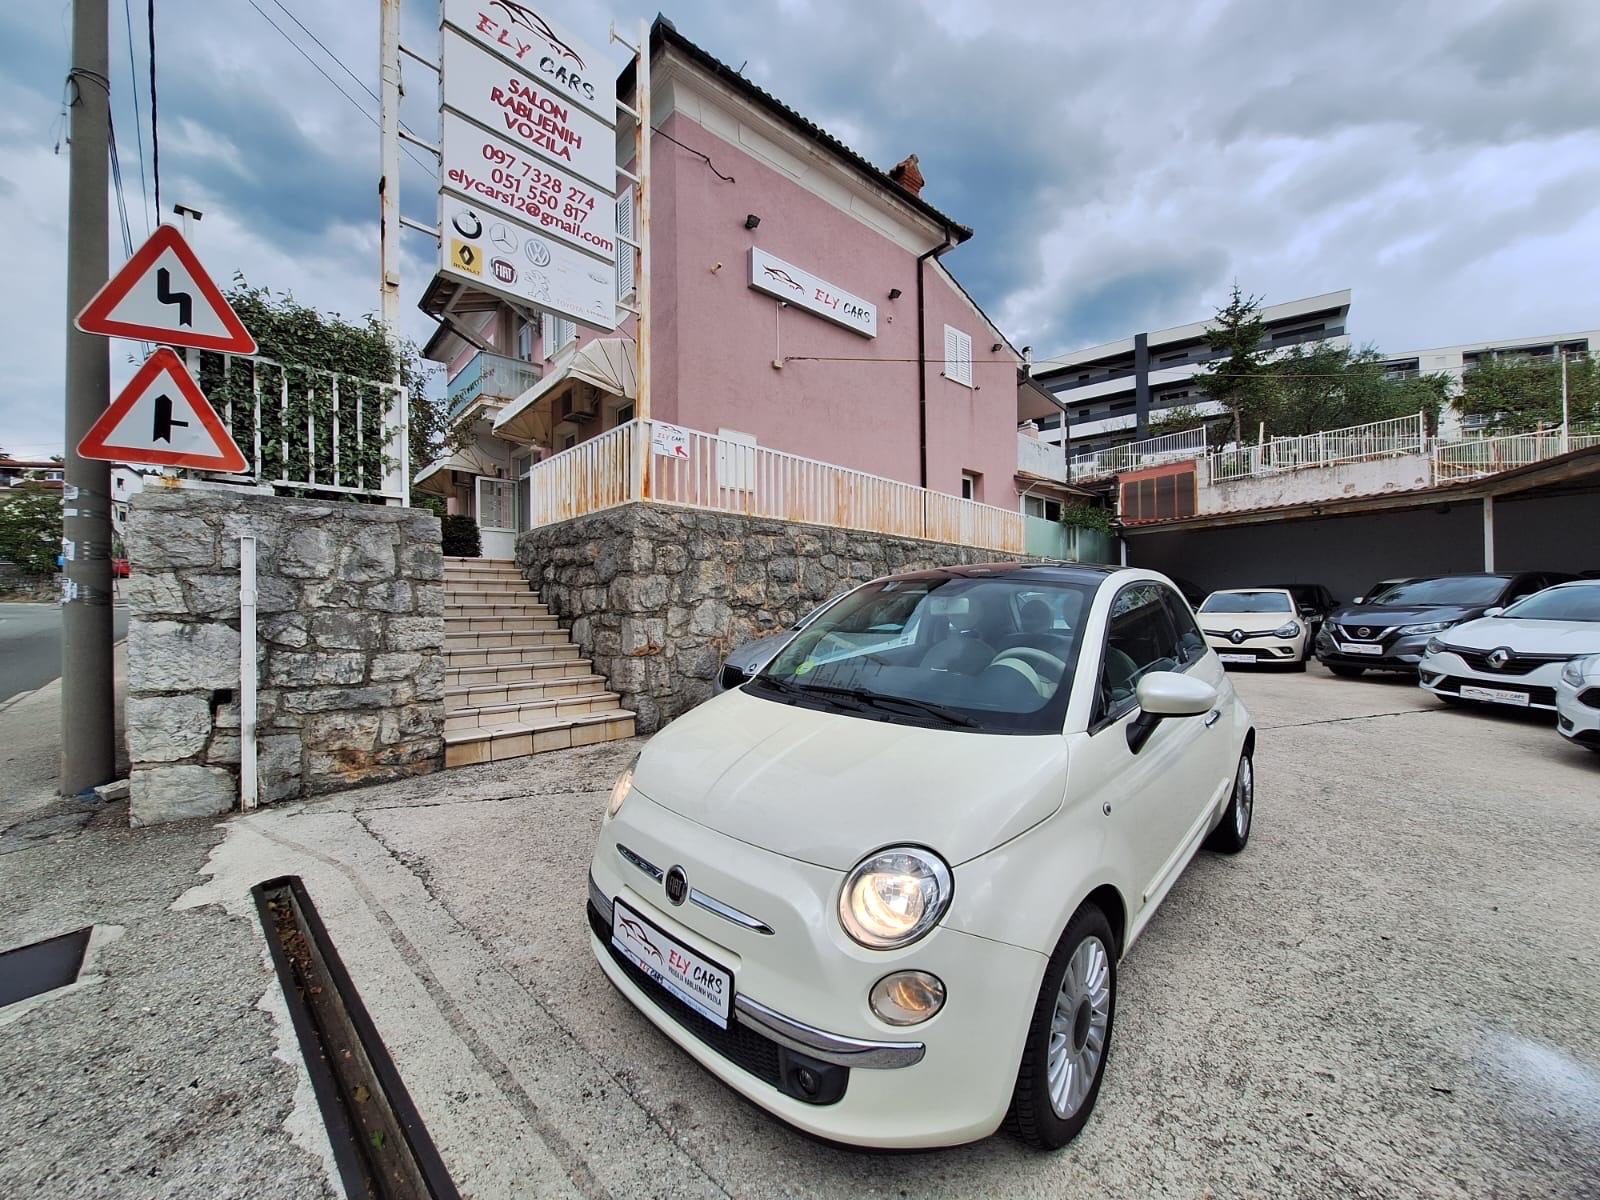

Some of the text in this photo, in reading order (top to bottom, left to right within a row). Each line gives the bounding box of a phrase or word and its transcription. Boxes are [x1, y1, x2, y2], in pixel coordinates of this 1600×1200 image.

[476, 12, 595, 101] ELY CARS
[490, 86, 582, 149] RABLJENIH
[508, 79, 567, 123] SALON
[504, 112, 571, 161] VOZILA
[482, 144, 595, 210] 097 7328 274
[491, 168, 588, 223] 051 550 817
[448, 168, 613, 252] elycars12@gmail.com
[495, 263, 512, 281] FIAT
[814, 288, 870, 323] ELY CARS
[669, 949, 722, 994] ELY CARS
